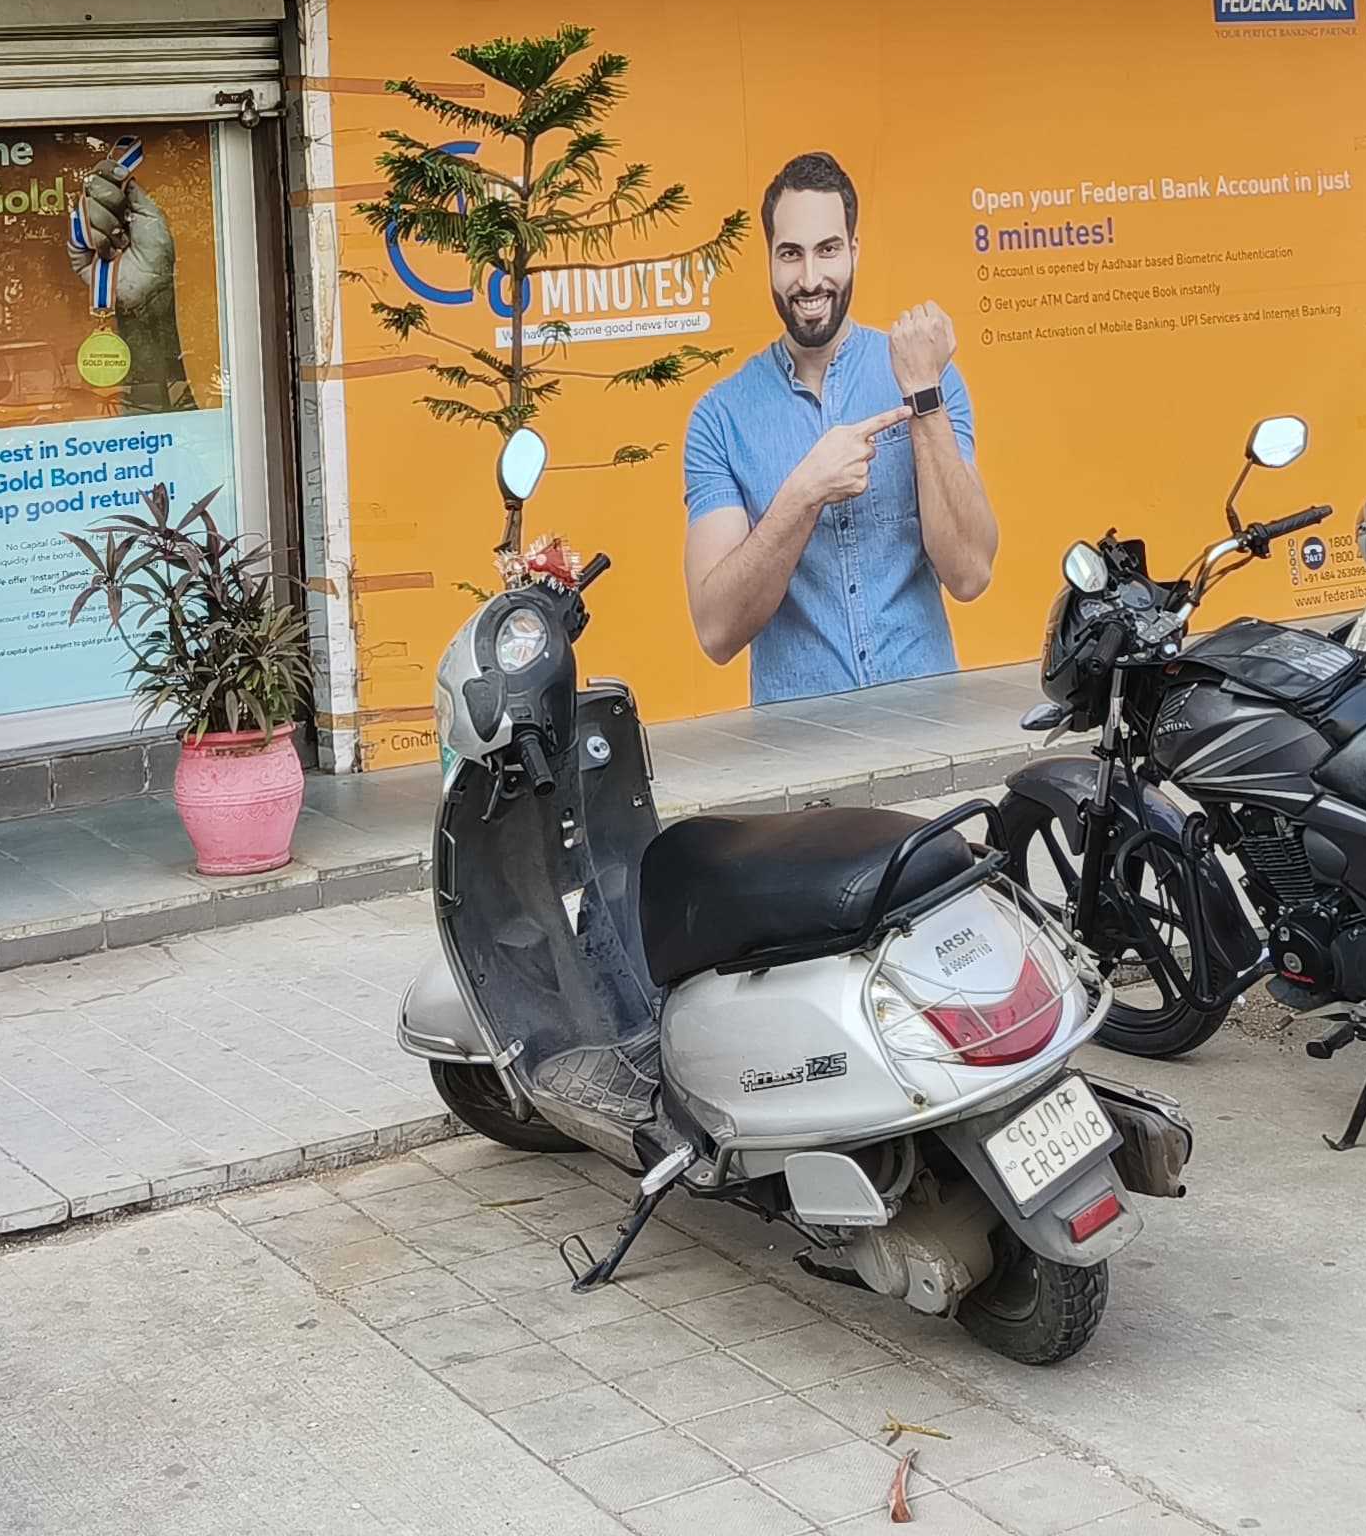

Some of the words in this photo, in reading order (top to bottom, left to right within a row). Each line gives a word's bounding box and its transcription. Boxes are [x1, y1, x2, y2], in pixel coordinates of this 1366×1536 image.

[972, 183, 1024, 215] Open
[1029, 185, 1073, 213] your
[1080, 179, 1155, 204] Federal
[1161, 175, 1210, 200] Bank
[1216, 170, 1290, 196] Account
[1295, 169, 1312, 192] in
[1316, 168, 1351, 196] just
[973, 223, 990, 253] 8
[998, 216, 1115, 251] minutes!
[993, 262, 1034, 280] Account
[1036, 263, 1046, 275] is
[1047, 260, 1084, 278] opened
[1087, 258, 1100, 274] by
[1101, 254, 1142, 271] Aadhaar
[1145, 253, 1174, 269] based
[1176, 249, 1223, 267] Biometric
[1225, 245, 1293, 264] Authentication
[995, 296, 1013, 311] Get
[1014, 297, 1038, 314] your
[1039, 292, 1063, 308] ATM
[1065, 291, 1090, 306] Card
[1092, 290, 1110, 304] and
[1112, 287, 1151, 304] Cheque
[1152, 285, 1178, 300] Book
[1179, 282, 1221, 299] instantly
[996, 327, 1034, 344] Instant
[1035, 323, 1086, 341] Activation
[1087, 322, 1098, 336] of
[1099, 319, 1133, 335] Mobile
[1180, 313, 1198, 328] UPI
[1199, 310, 1241, 326] Services
[1242, 308, 1260, 322] and
[1262, 305, 1300, 321] Internet
[1301, 303, 1342, 322] Banking
[39, 440, 59, 460] in
[65, 430, 174, 463] Sovereign
[50, 464, 108, 487] Bond
[114, 458, 154, 482] and
[934, 925, 977, 960] ARSH
[804, 1052, 848, 1082] 125
[1021, 1111, 1105, 1186] ER9908
